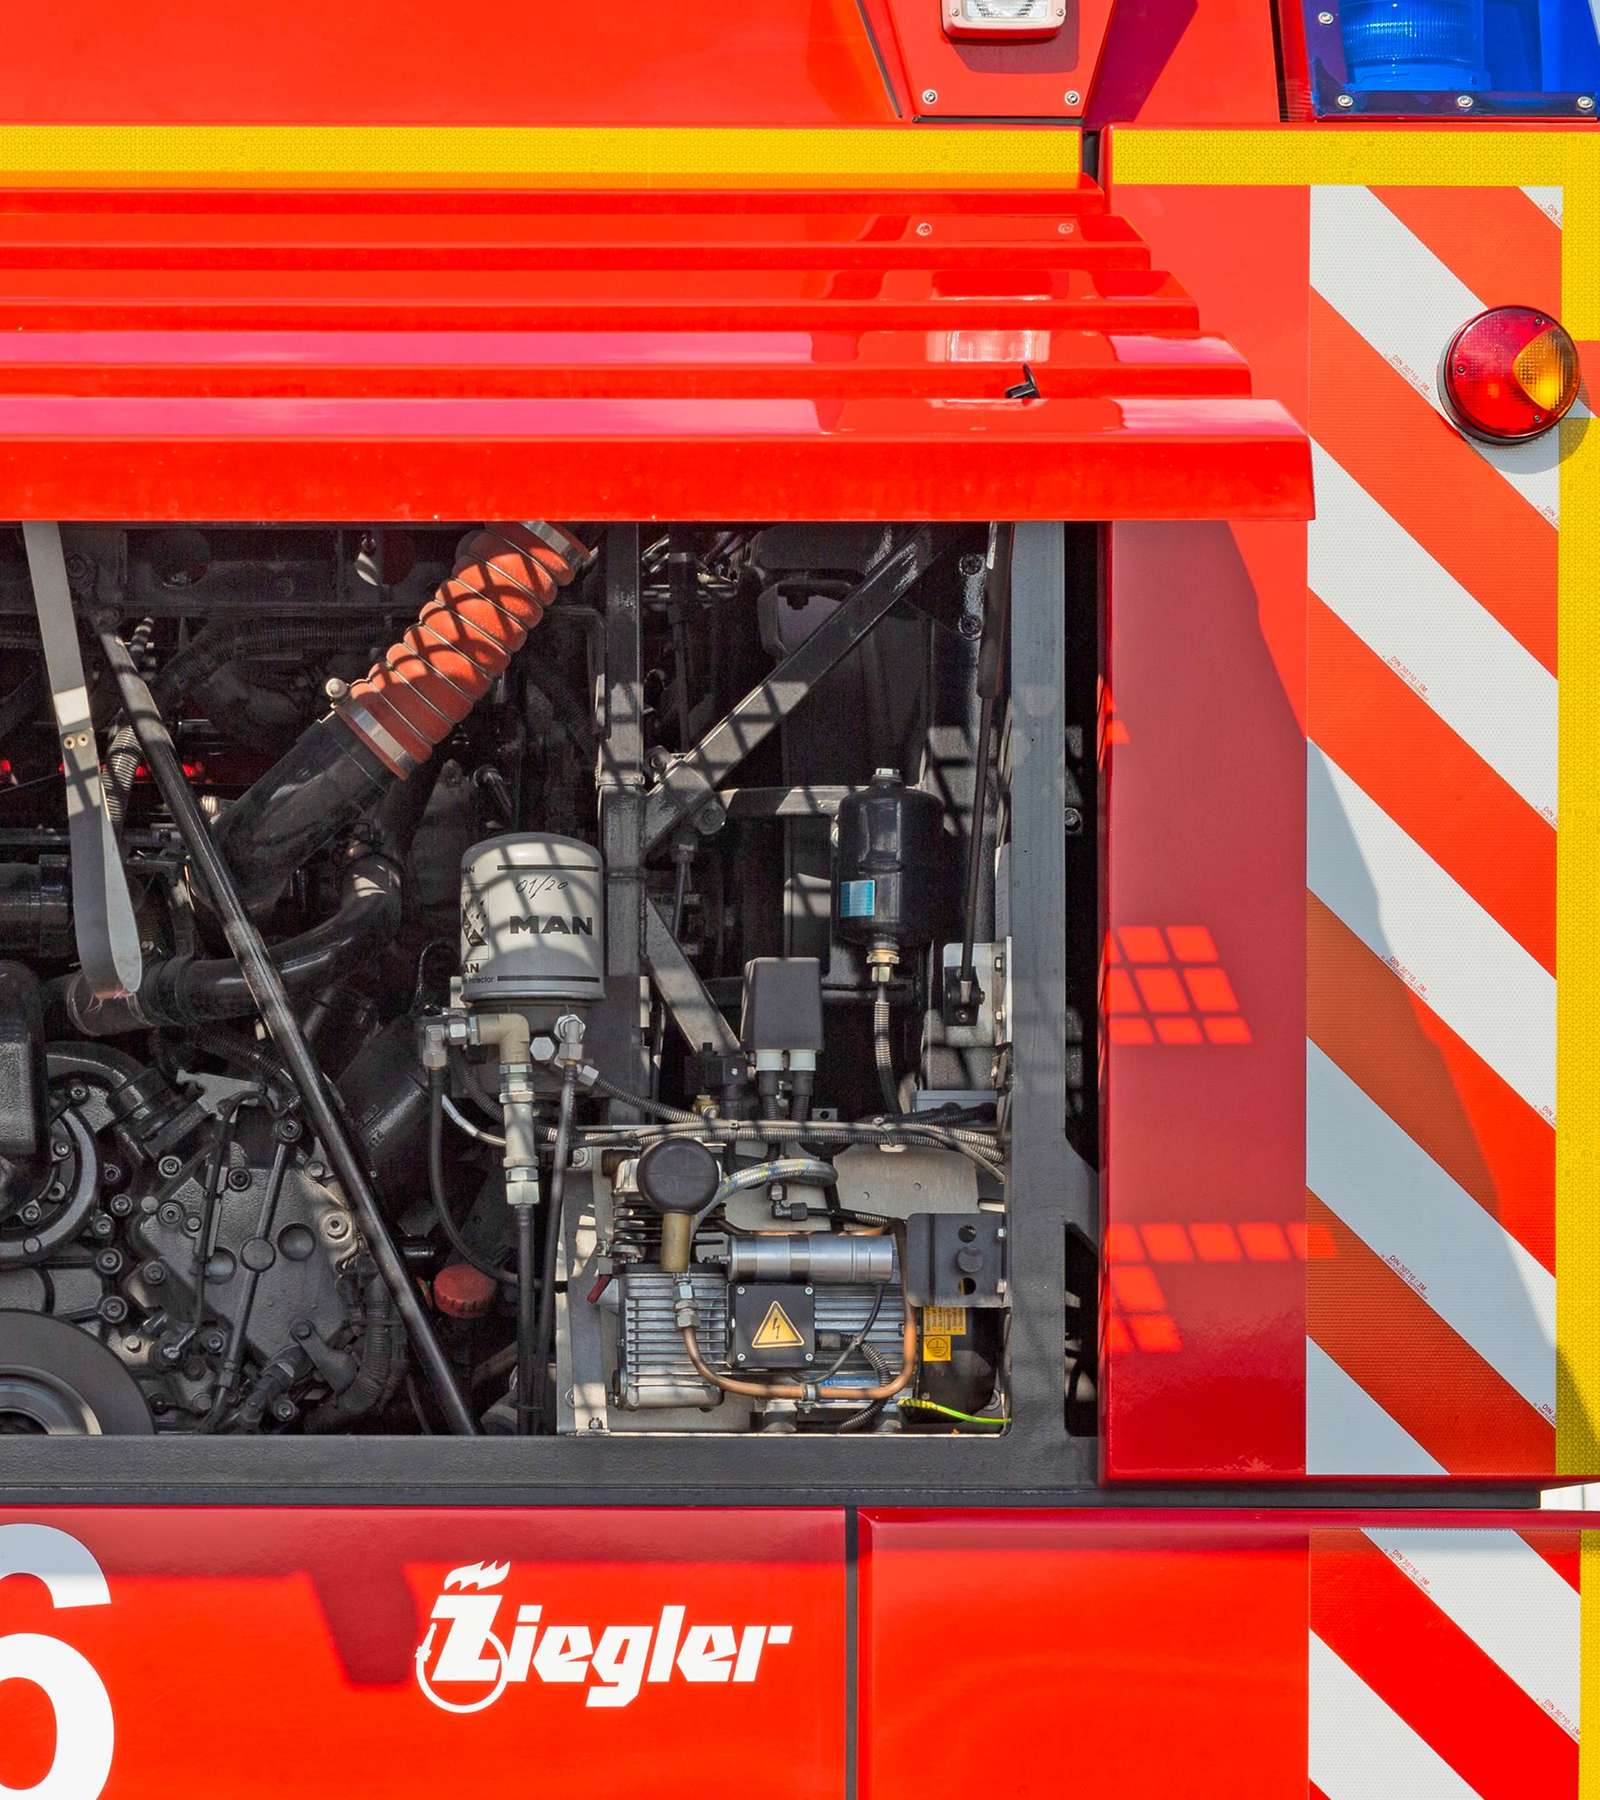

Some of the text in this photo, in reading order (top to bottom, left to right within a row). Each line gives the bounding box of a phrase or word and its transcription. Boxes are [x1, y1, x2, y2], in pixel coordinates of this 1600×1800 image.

[516, 875, 569, 899] 01/20
[510, 915, 593, 936] MAN
[1542, 1404, 1553, 1414] DIN
[426, 1588, 793, 1711] Ziegler
